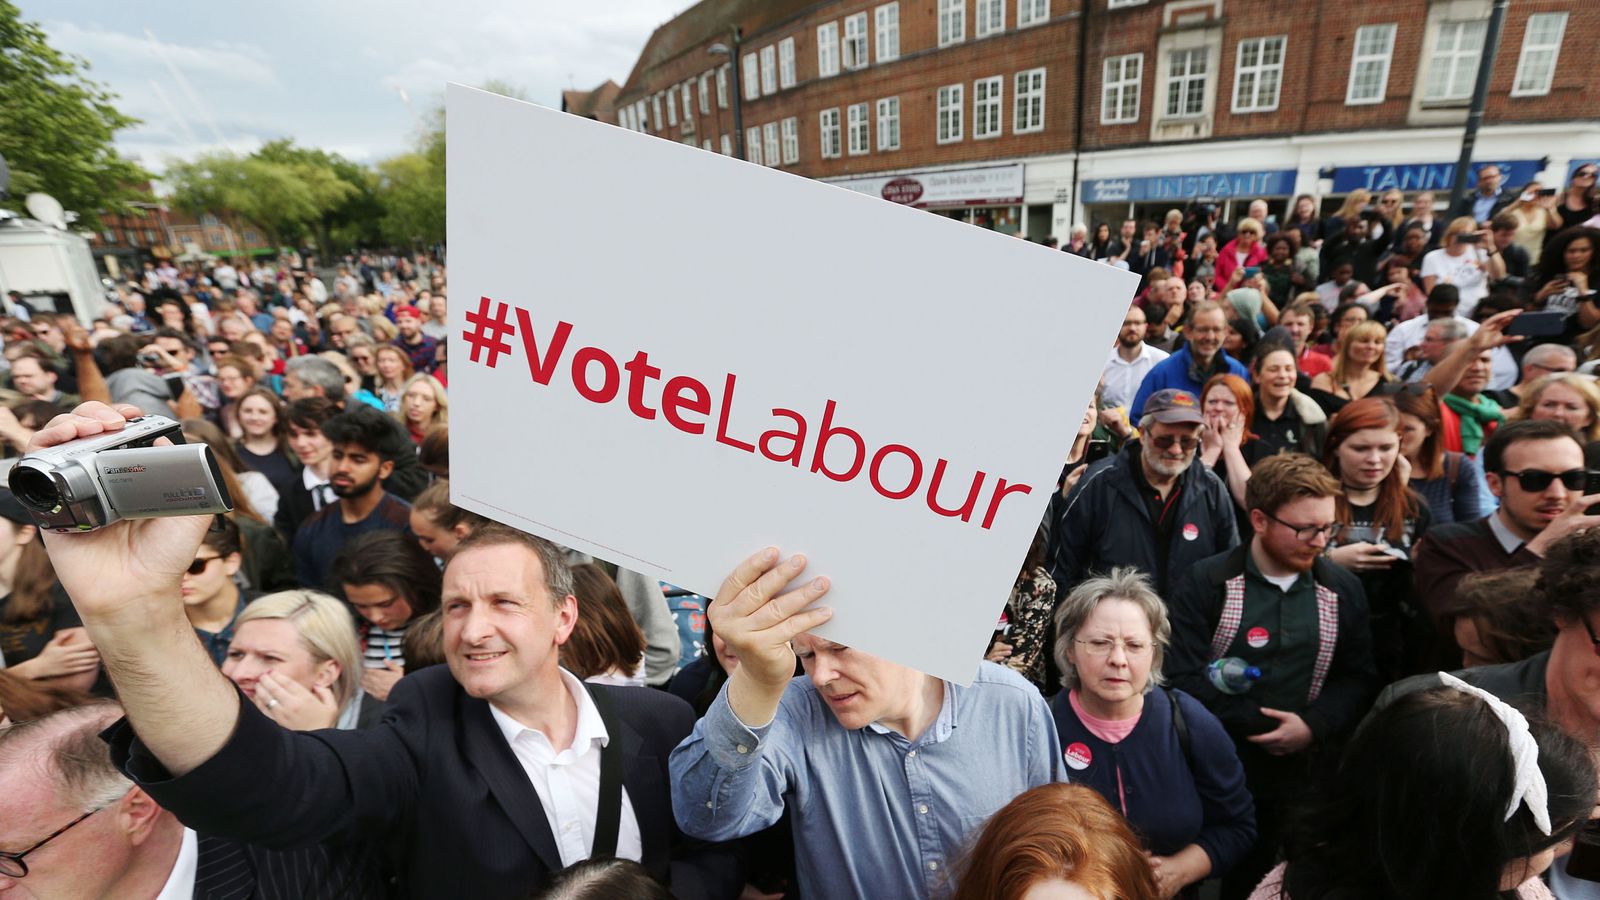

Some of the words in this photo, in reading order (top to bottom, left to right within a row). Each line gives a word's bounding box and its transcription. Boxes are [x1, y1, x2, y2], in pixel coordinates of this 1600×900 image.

[1154, 172, 1272, 198] INSTANT
[462, 296, 1032, 529] #VoteLabour
[103, 464, 146, 475] Panasonic
[1067, 749, 1091, 763] Labour
